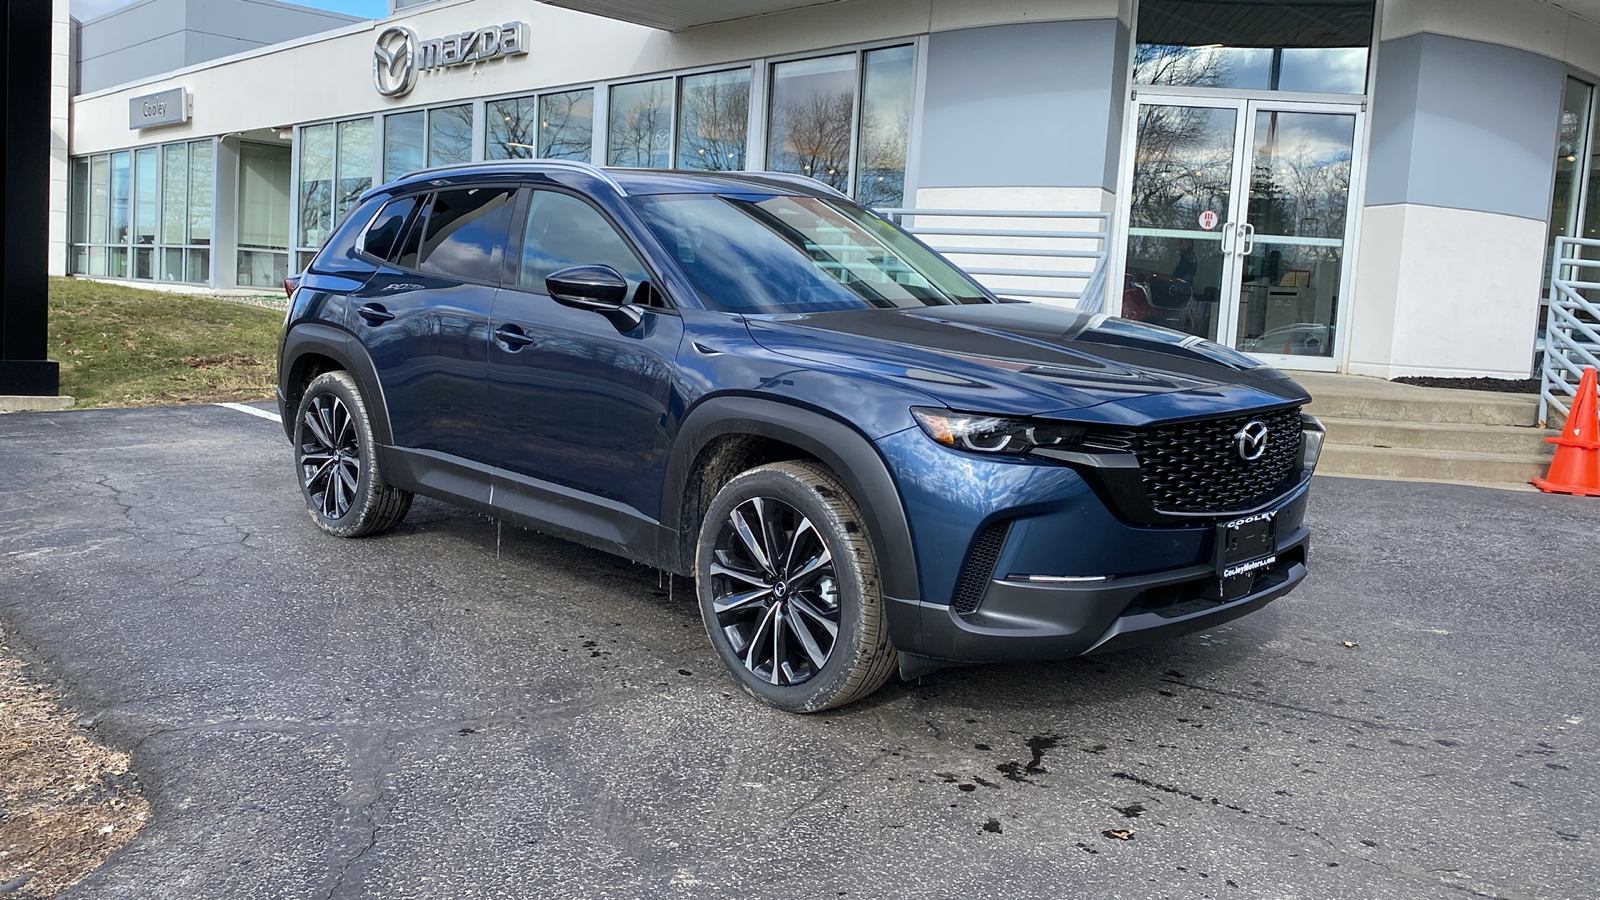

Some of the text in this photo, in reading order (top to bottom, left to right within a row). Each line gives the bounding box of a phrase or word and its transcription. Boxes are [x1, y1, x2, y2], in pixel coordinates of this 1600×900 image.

[142, 97, 167, 119] Cooley
[1227, 510, 1278, 528] COOLEY
[1223, 556, 1276, 577] CooleyMotors.com
